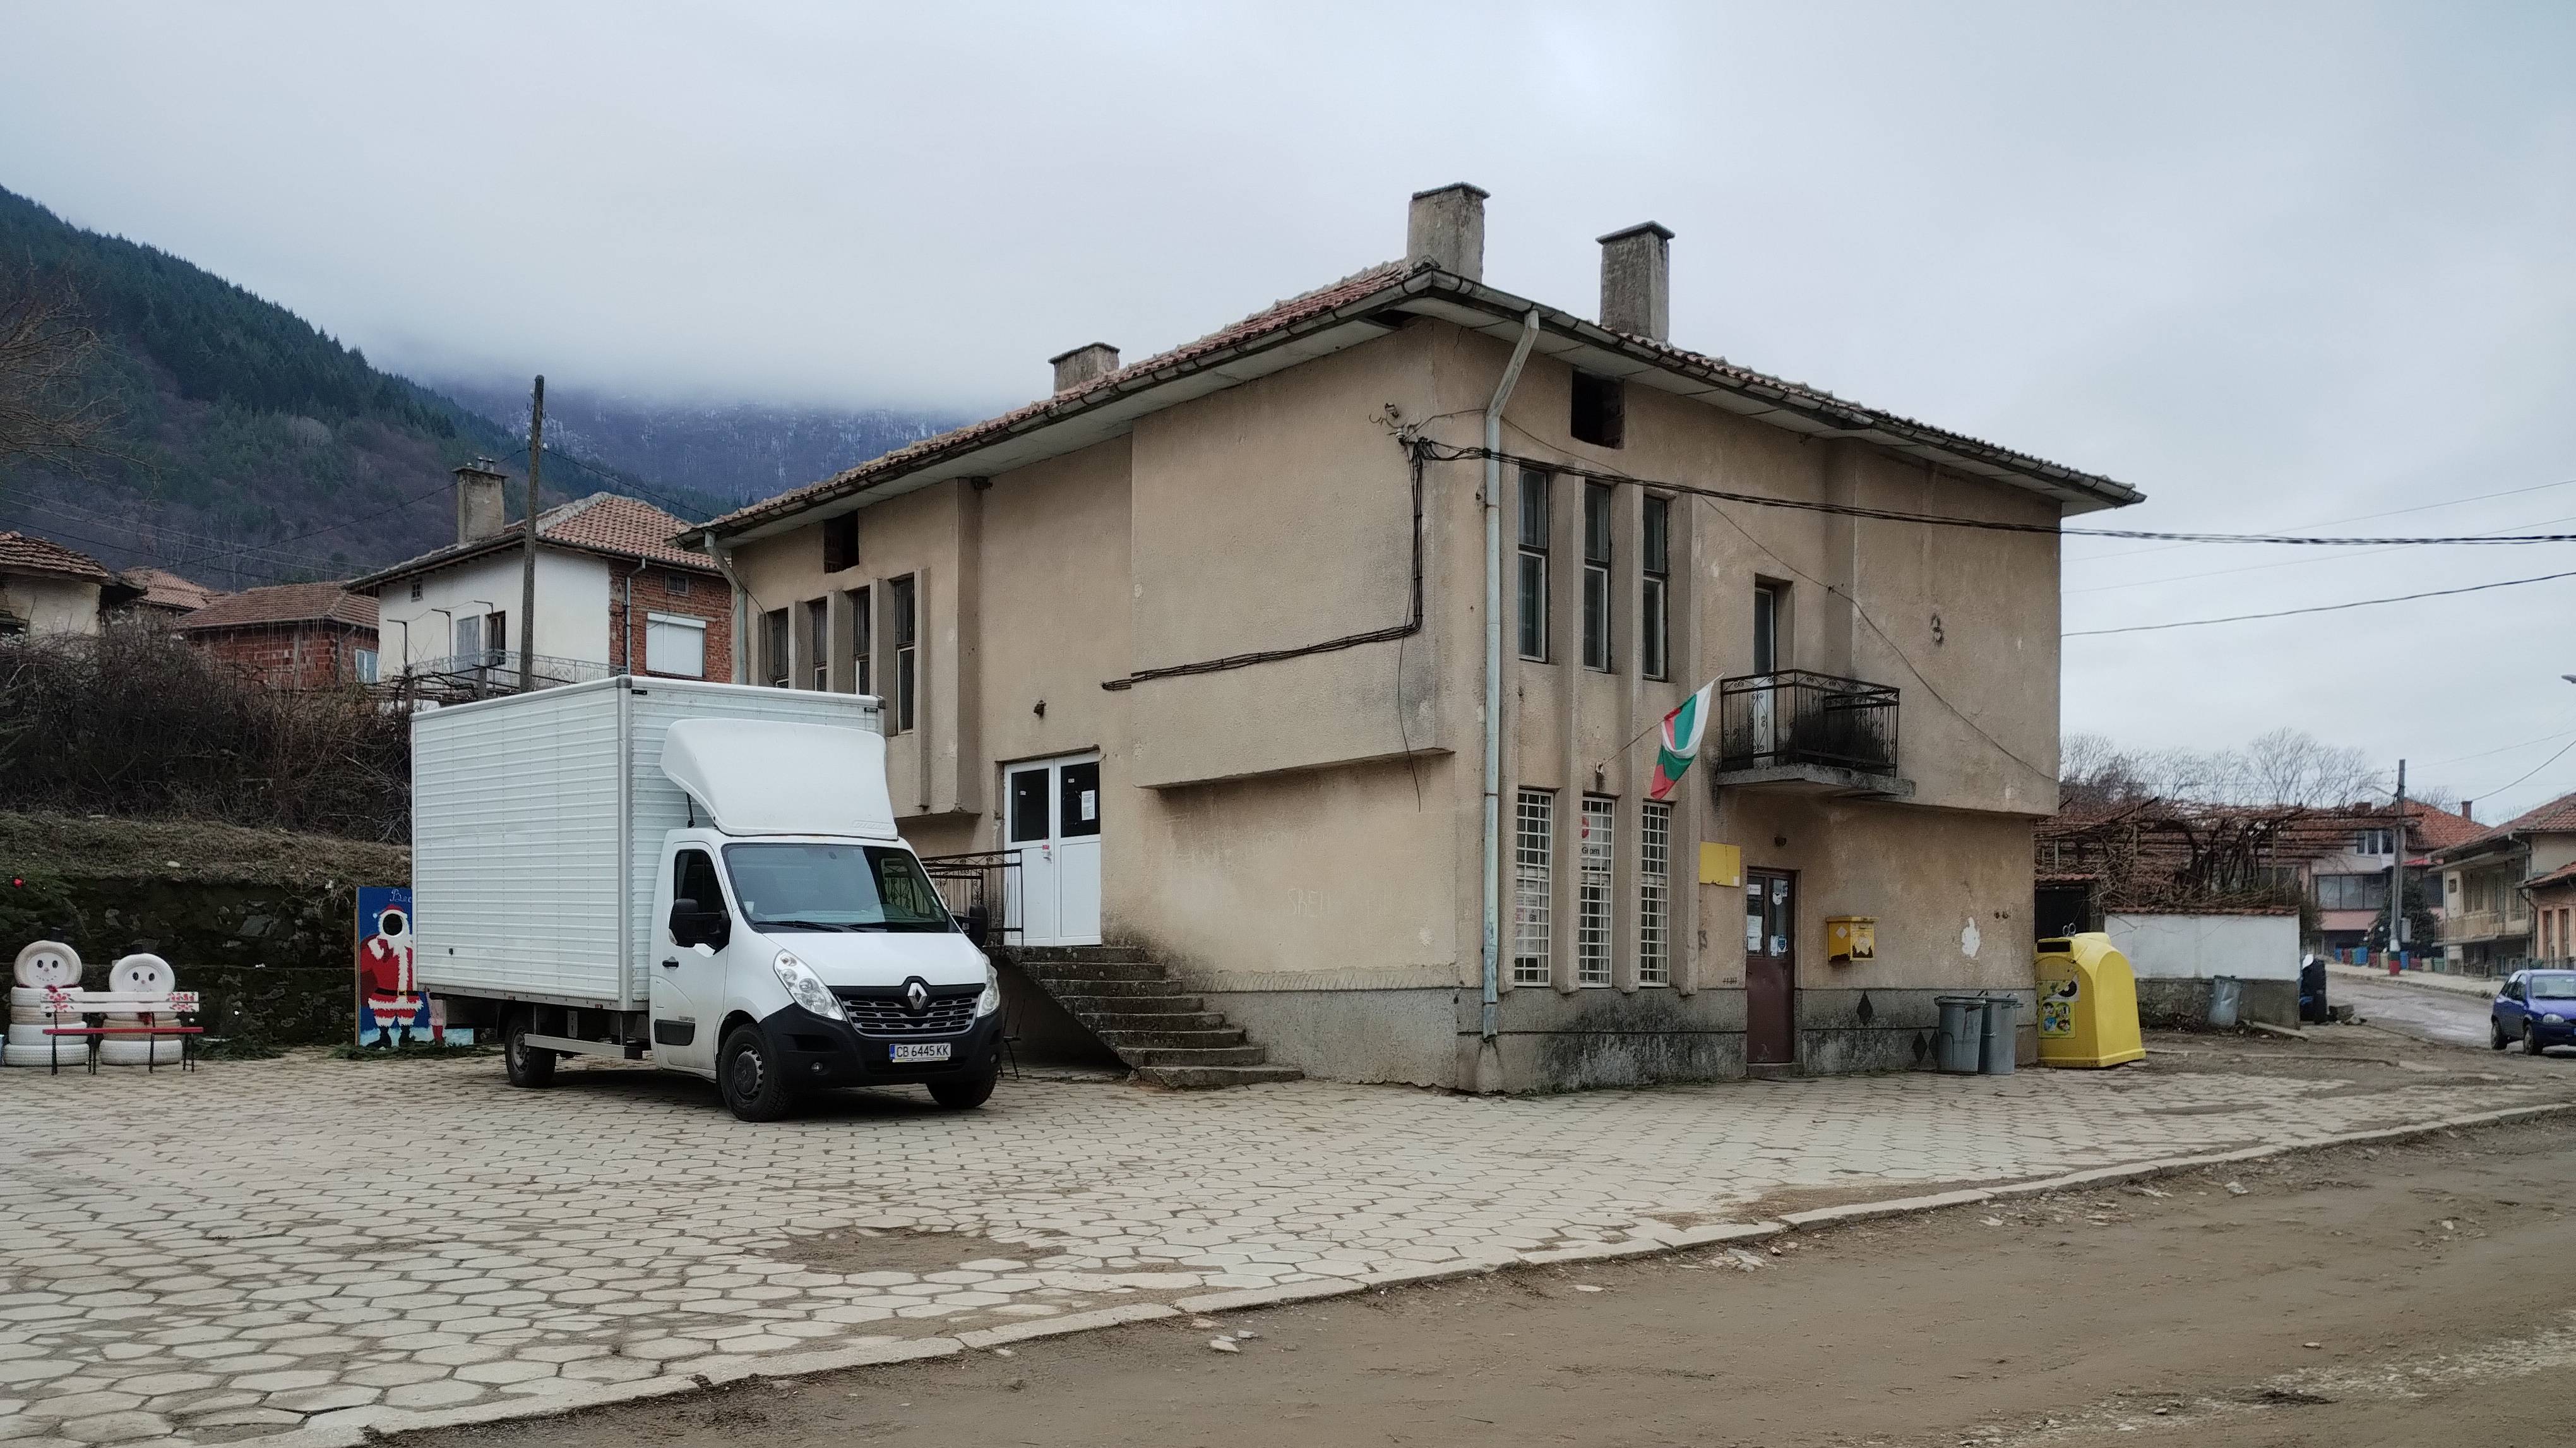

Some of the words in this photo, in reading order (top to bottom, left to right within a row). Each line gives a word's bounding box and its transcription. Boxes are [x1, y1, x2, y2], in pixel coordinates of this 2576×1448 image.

[897, 1046, 909, 1057] CB
[911, 1046, 935, 1056] 6445
[936, 1044, 949, 1056] KK
